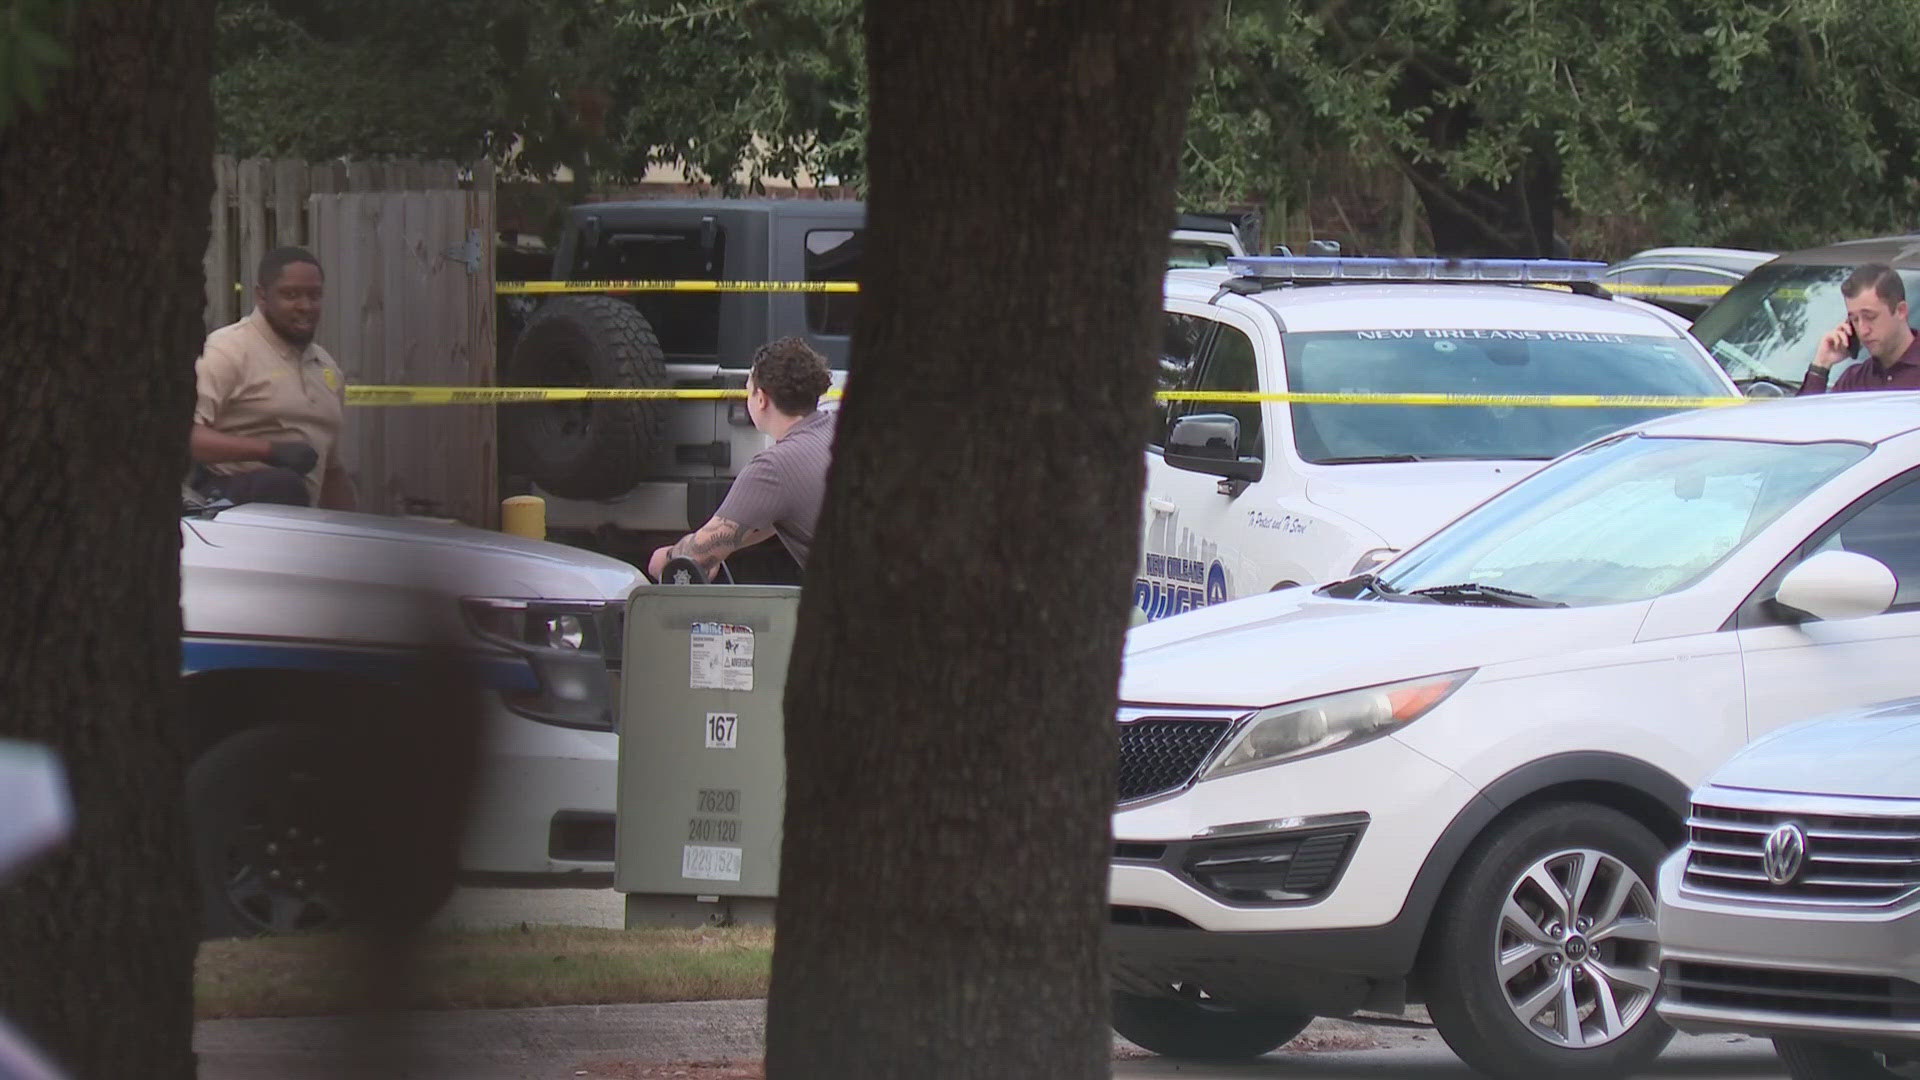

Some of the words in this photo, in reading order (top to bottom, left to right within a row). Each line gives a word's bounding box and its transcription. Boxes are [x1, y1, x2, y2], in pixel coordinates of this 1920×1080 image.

[1357, 329, 1414, 340] NEW
[1424, 328, 1541, 340] ORLEANS
[1547, 331, 1631, 344] POLICE
[1146, 553, 1166, 578] NEW
[1167, 556, 1204, 584] ORLEANS
[1133, 578, 1204, 622] OLICE
[709, 716, 735, 741] 167
[699, 791, 735, 812] 7620
[1567, 943, 1585, 953] KIA
